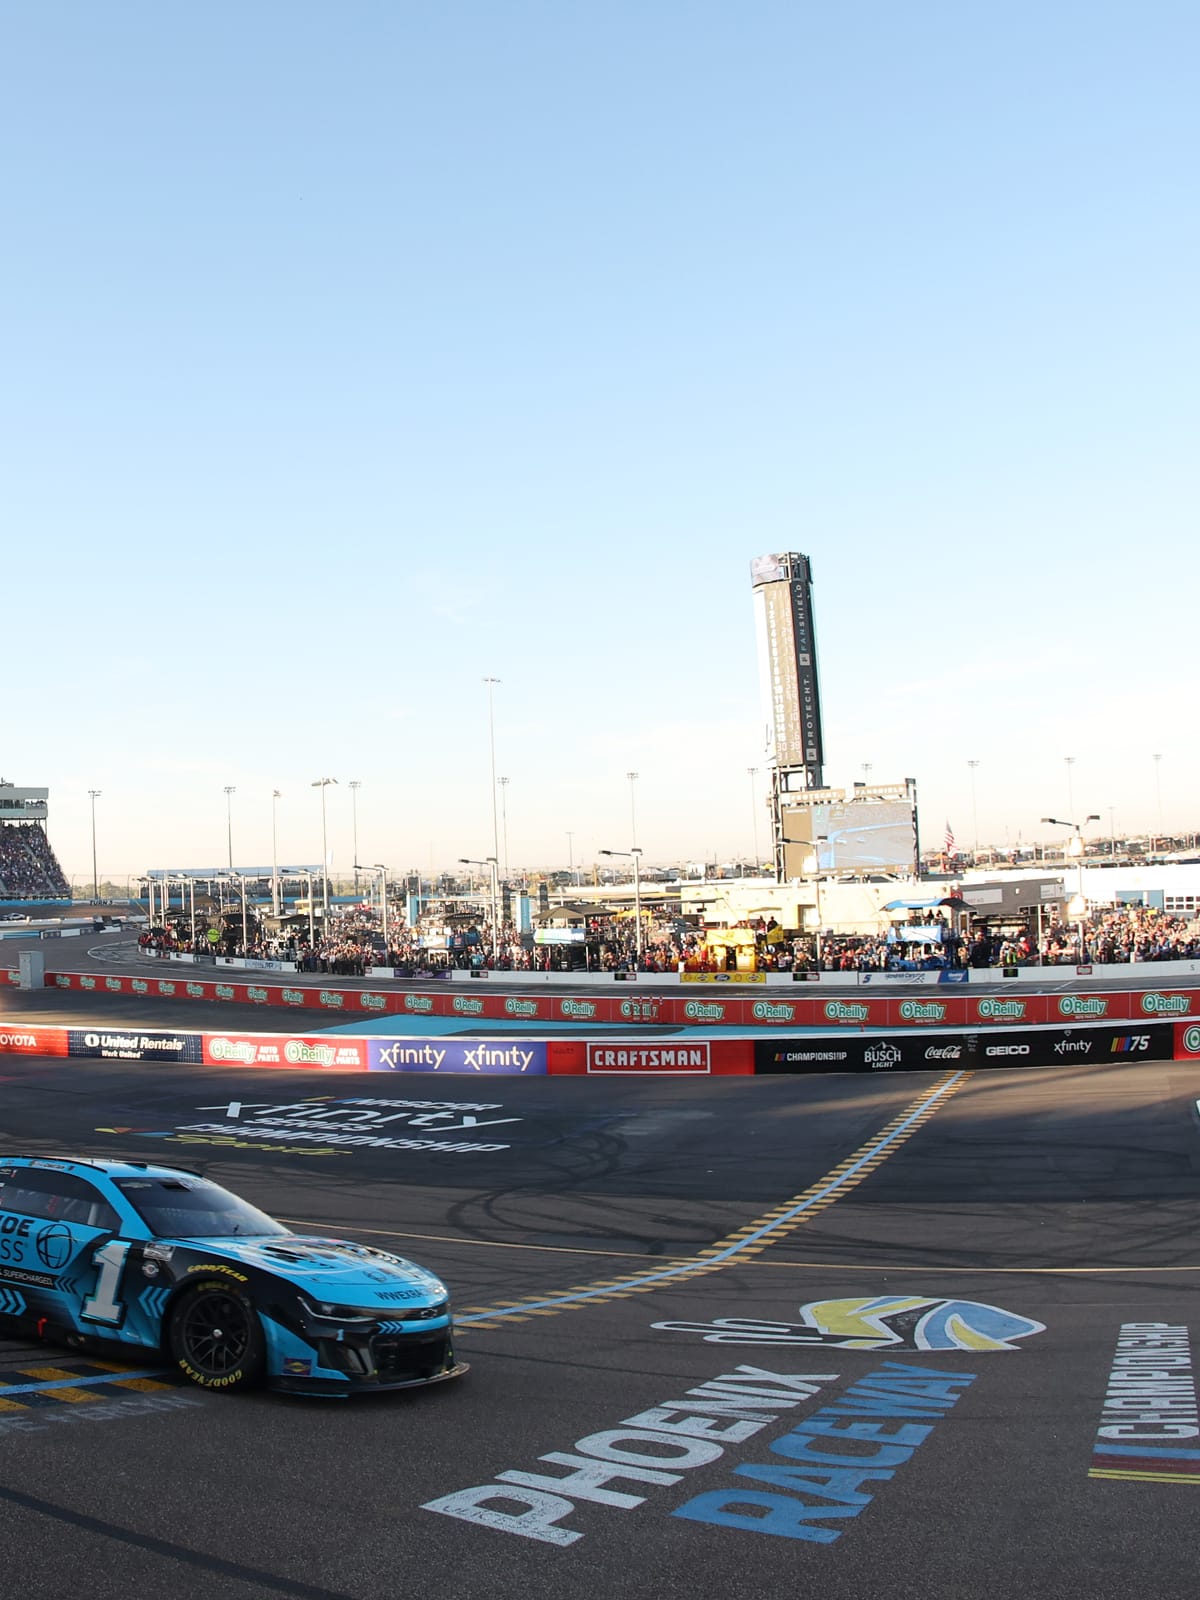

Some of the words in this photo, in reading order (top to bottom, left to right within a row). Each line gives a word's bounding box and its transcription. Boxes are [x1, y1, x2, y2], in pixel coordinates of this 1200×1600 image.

[796, 584, 808, 652] FANSHIELD
[405, 994, 432, 1009] O'Reilly
[454, 996, 483, 1012] O'Reilly
[506, 998, 537, 1014] O'Reilly
[561, 1000, 596, 1016] O'Reilly
[686, 1000, 725, 1019] O'Reilly
[753, 1000, 795, 1020] O'Reilly
[826, 1000, 869, 1020] O'Reilly
[900, 1000, 947, 1020] O'Reilly
[978, 998, 1025, 1017] O'Reilly
[1059, 995, 1108, 1016] O'Reilly
[1142, 993, 1191, 1013] O'Reilly
[101, 1035, 138, 1049] United
[139, 1037, 183, 1051] Rentals
[211, 1039, 256, 1064] O'Reilly
[259, 1046, 278, 1054] AUTO
[986, 1045, 1030, 1056] GEICO
[1054, 1039, 1092, 1055] xfinity
[1129, 1035, 1151, 1051] 75
[258, 1054, 280, 1063] PARTS
[286, 1041, 335, 1065] O'Reilly
[337, 1056, 360, 1065] PARTS
[339, 1048, 358, 1057] AUTO
[379, 1043, 446, 1069] xfinity
[463, 1045, 534, 1071] xfinity
[594, 1050, 702, 1067] CRAFTSMAN
[786, 1052, 847, 1062] CHAMPIONSHIP
[864, 1049, 902, 1063] BUSCH
[175, 1123, 511, 1153] CHAMPIONSHIP
[80, 1239, 133, 1324] 1
[187, 1264, 248, 1282] GOODYEAR
[179, 1359, 243, 1387] GOODYEAR
[1097, 1322, 1200, 1439] CHAMPIONSHIP
[418, 1364, 841, 1547] PHOENIX
[670, 1361, 978, 1546] RACEWAY
